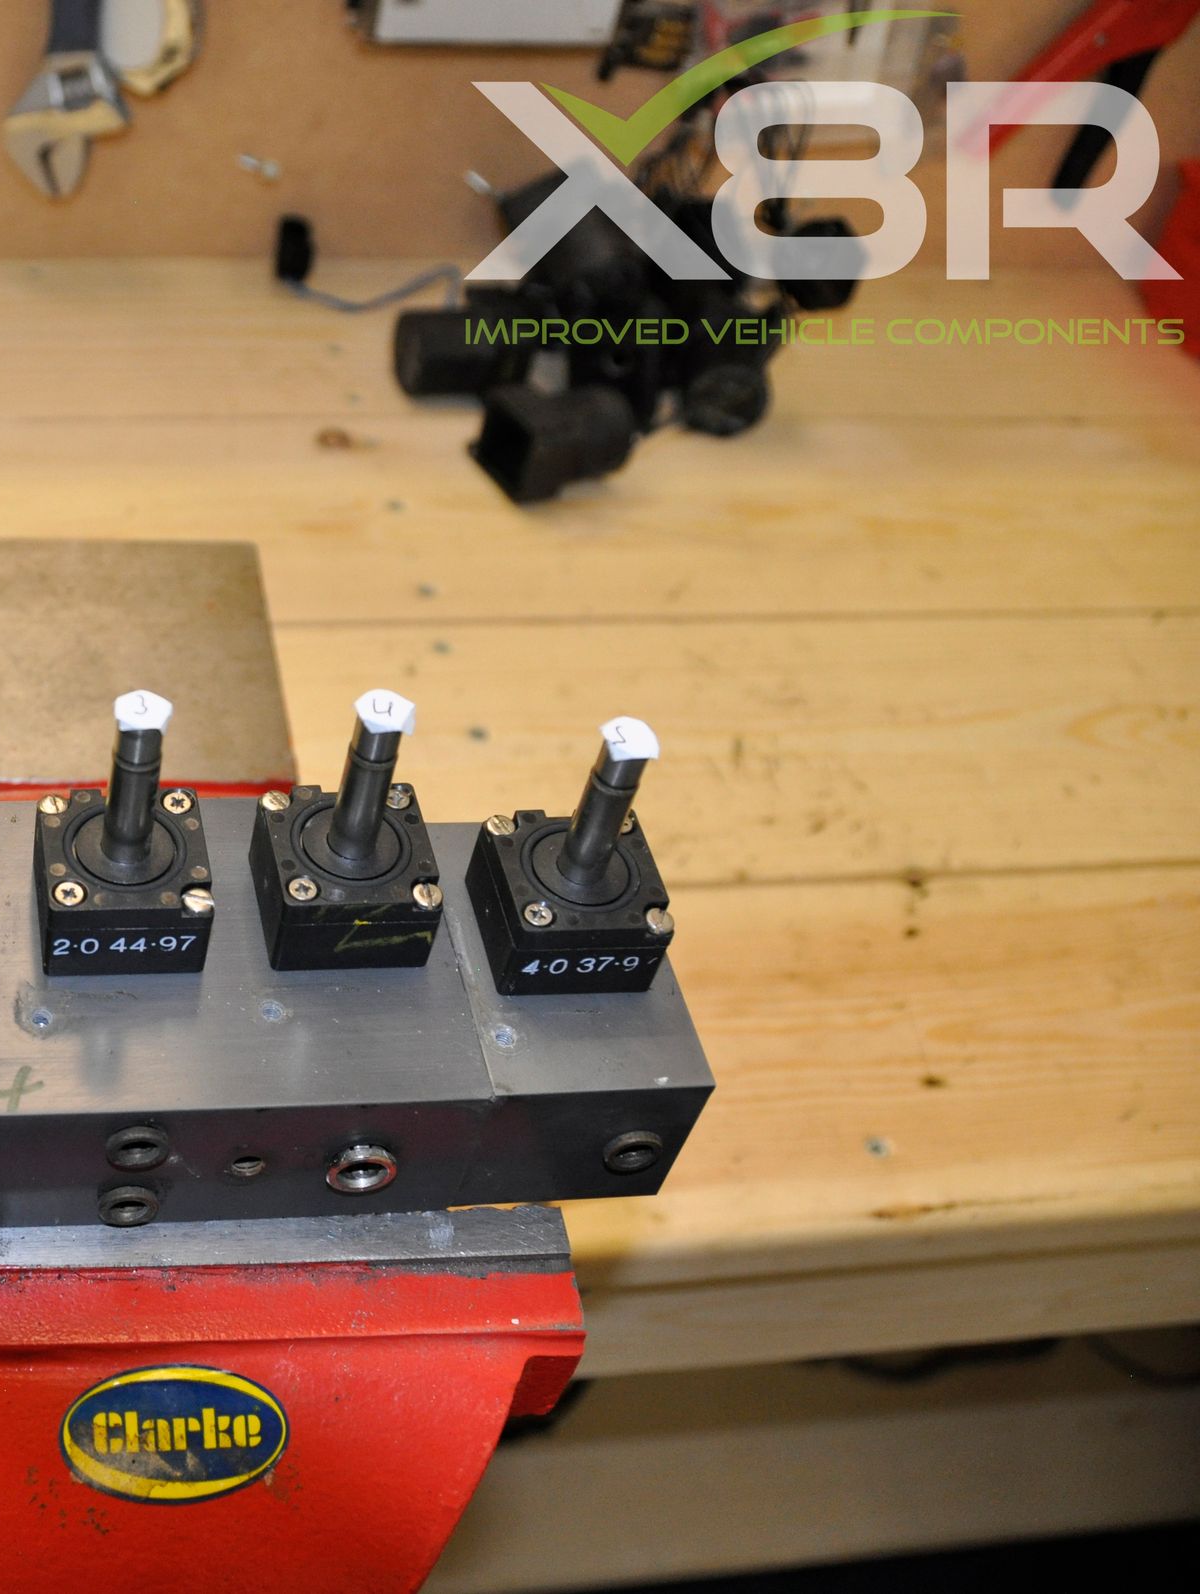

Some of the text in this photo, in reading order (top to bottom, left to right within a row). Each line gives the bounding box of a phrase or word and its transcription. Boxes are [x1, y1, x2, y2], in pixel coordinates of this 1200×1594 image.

[133, 694, 148, 715] 3
[372, 698, 393, 717] 4
[92, 1407, 261, 1454] Clarke
